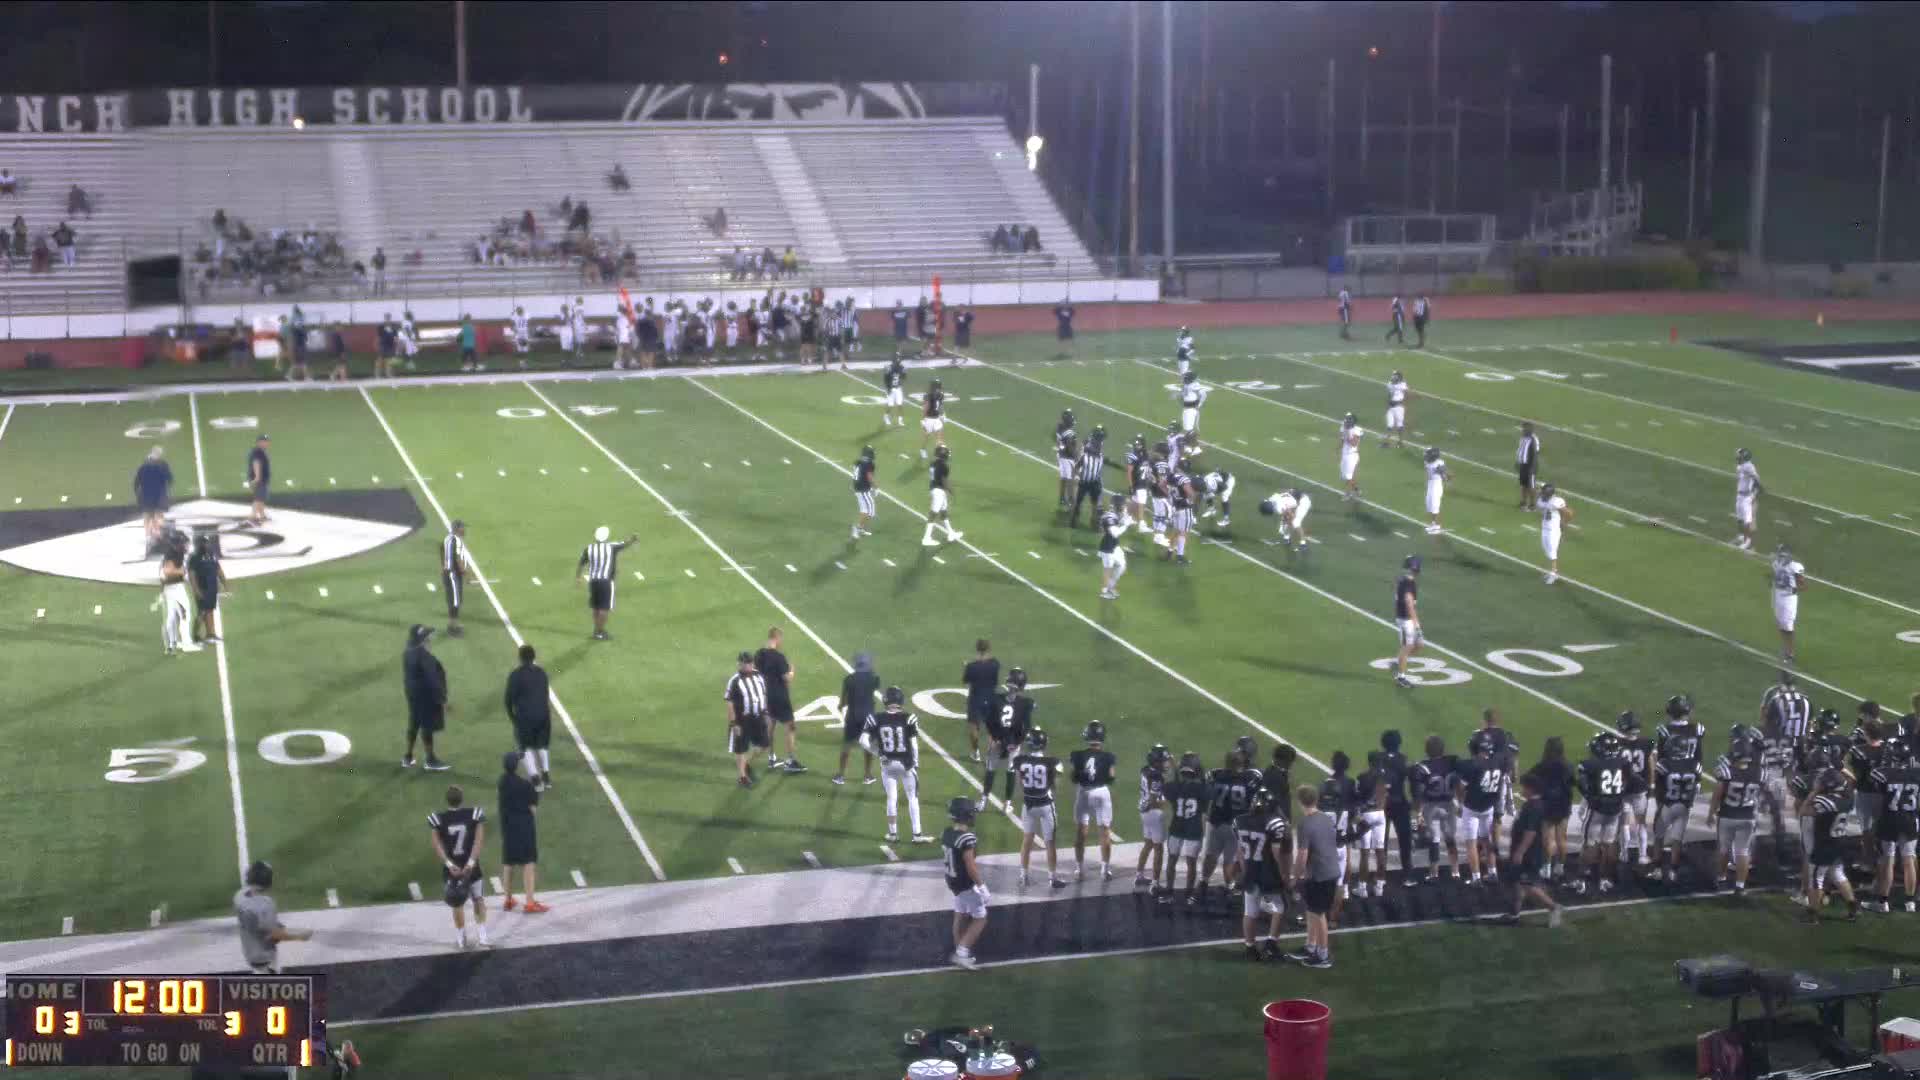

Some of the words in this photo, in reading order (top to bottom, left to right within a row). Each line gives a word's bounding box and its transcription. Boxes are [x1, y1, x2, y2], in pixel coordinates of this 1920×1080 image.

[0, 95, 128, 132] NCH
[166, 87, 298, 127] HIGH
[331, 86, 533, 125] SCHOOL
[1001, 706, 1014, 728] 2
[880, 726, 906, 752] 81
[104, 729, 351, 782] 50
[1020, 763, 1048, 789] 39
[1084, 757, 1097, 781] 4
[1480, 769, 1501, 793] 42
[1601, 768, 1623, 795] 24
[1176, 798, 1198, 819] 12
[1887, 783, 1920, 811] 73
[447, 824, 467, 855] 7
[1239, 830, 1266, 862] 57
